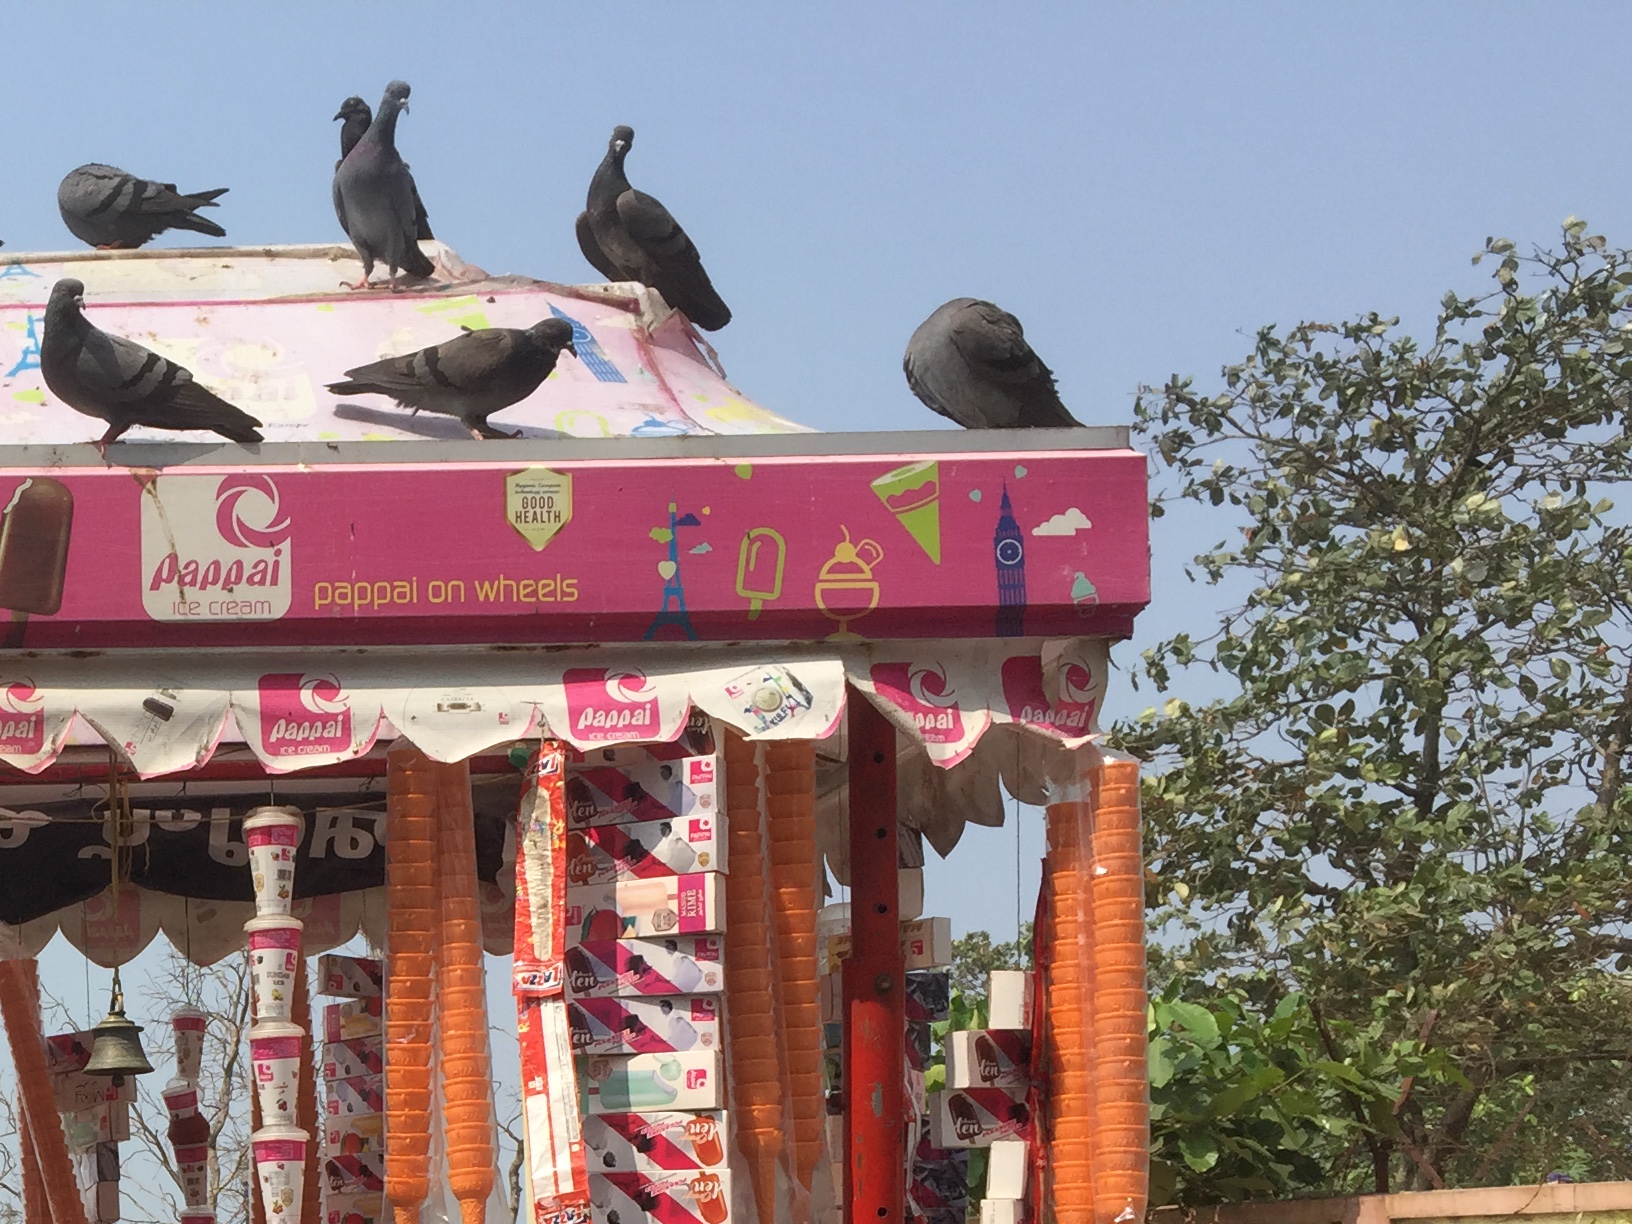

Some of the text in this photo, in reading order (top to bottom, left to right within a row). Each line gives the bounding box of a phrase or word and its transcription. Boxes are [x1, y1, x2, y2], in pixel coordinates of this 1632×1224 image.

[521, 496, 554, 509] GOOD
[515, 510, 561, 523] HEALTH
[314, 572, 578, 610] pappai on wheels
[172, 599, 272, 616] ice cream
[607, 731, 640, 740] cream
[279, 744, 330, 755] ice cream
